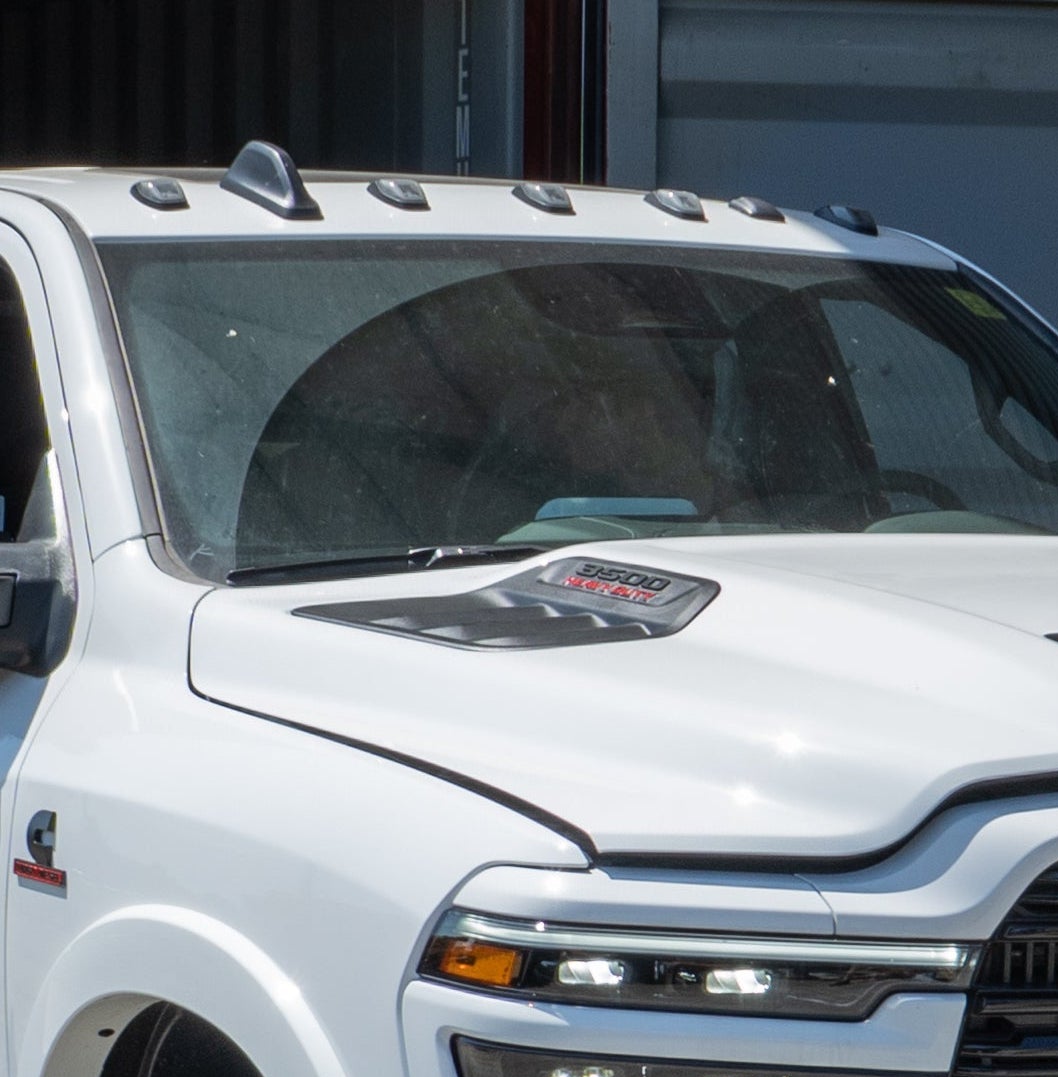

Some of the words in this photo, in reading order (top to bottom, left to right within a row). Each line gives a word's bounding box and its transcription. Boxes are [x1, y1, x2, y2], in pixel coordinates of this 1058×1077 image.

[562, 576, 611, 593] HEAVY
[610, 585, 656, 602] DUTY
[575, 563, 671, 592] 3500
